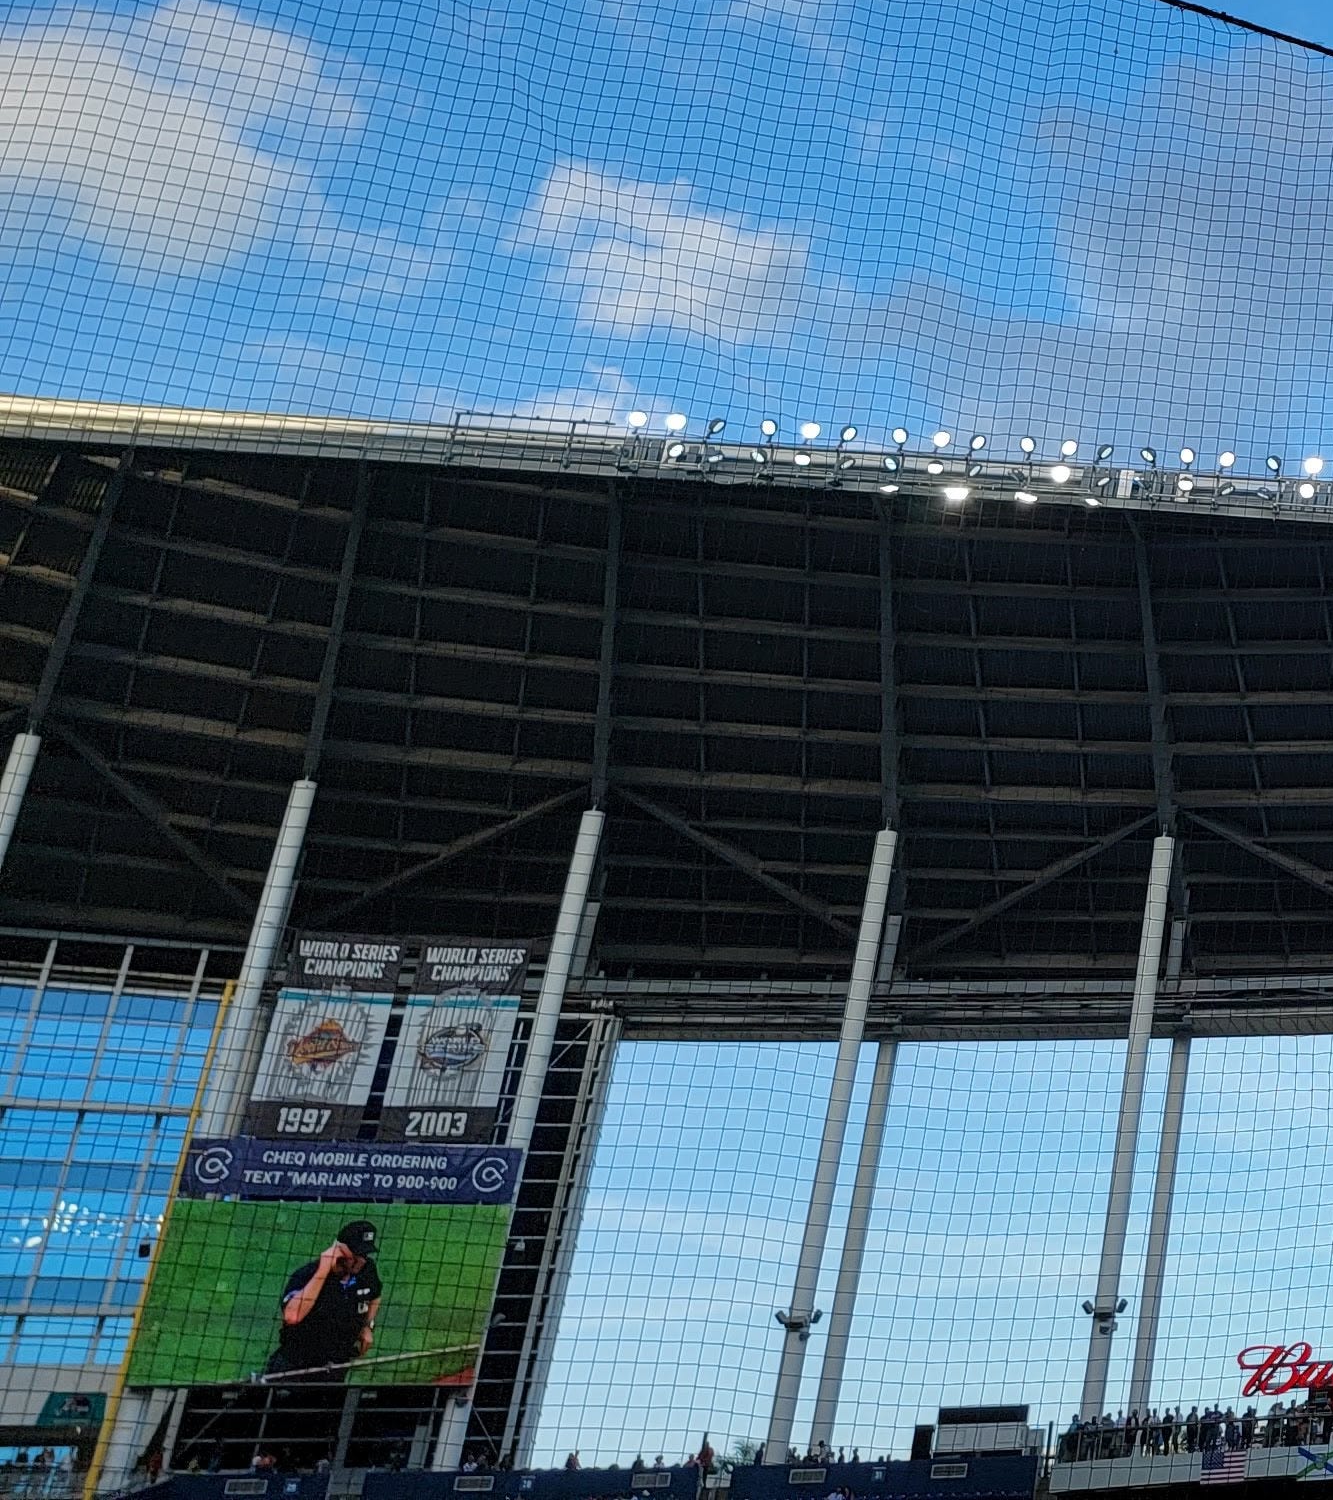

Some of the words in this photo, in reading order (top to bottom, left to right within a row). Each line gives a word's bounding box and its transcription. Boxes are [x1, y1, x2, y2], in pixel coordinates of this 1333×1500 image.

[300, 939, 349, 958] WORLD
[351, 942, 400, 962] SERIES
[426, 946, 476, 964] WORLD
[478, 948, 526, 965] SERIES
[304, 958, 386, 979] CHAMPIONS
[431, 965, 512, 982] CHAMPIONS
[277, 1106, 332, 1134] 1997
[405, 1111, 468, 1137] 2003
[263, 1150, 306, 1165] CHEQ
[309, 1151, 366, 1168] MOBILE
[370, 1154, 448, 1171] ORDERING
[243, 1170, 284, 1185] TEXT
[374, 1174, 394, 1189] TO
[397, 1175, 458, 1191] 900-900
